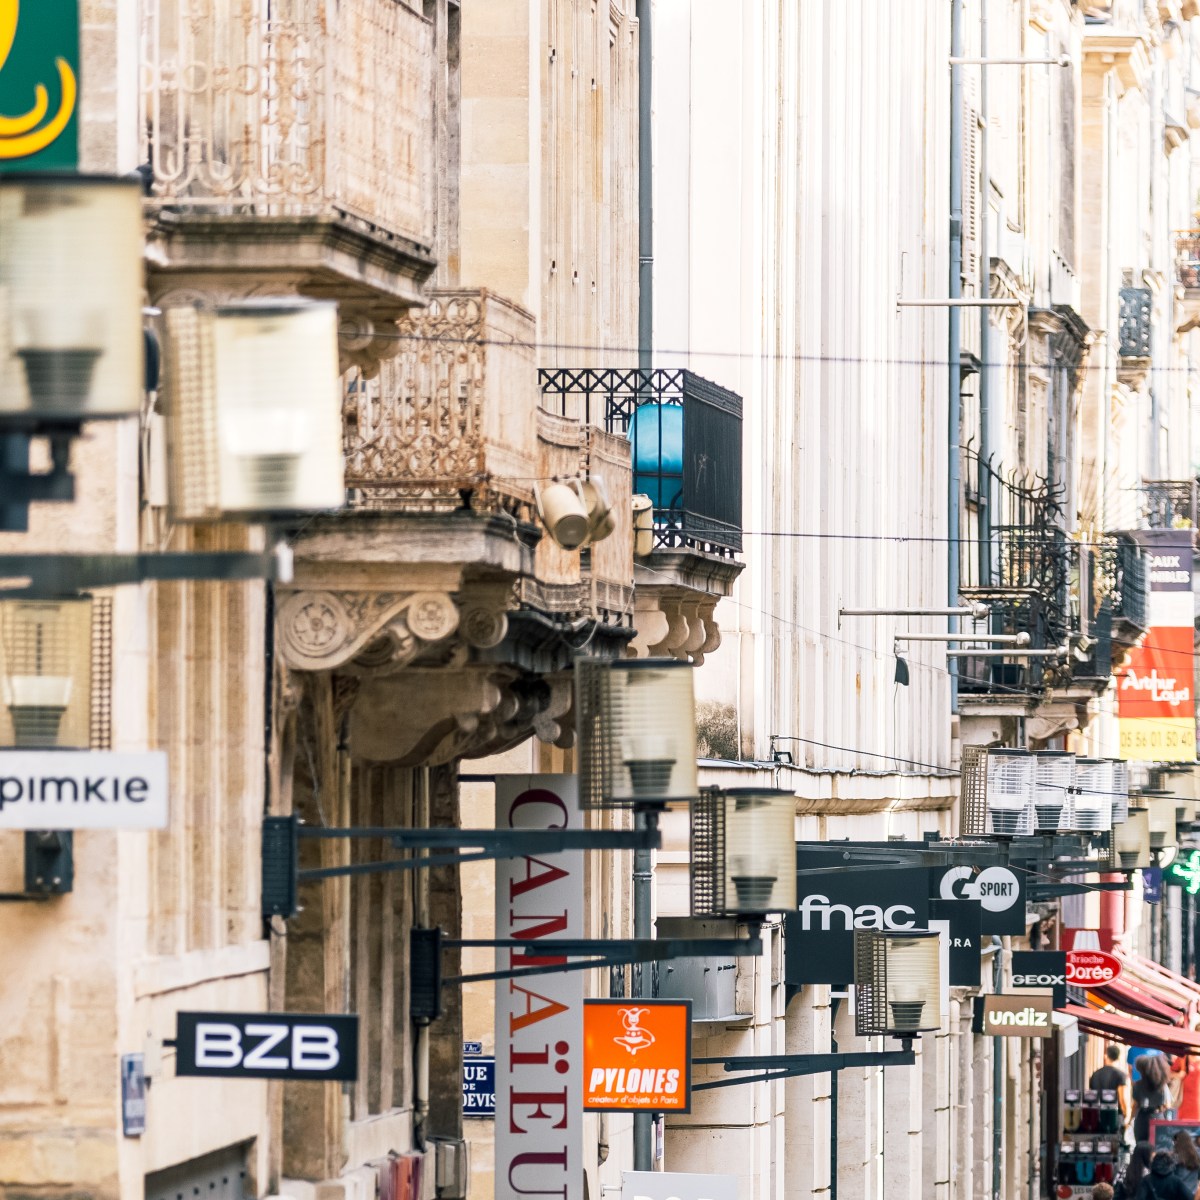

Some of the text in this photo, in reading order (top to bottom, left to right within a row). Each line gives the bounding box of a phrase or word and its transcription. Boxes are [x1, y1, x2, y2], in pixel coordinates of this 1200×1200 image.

[1122, 669, 1176, 691] Arthur
[0, 776, 149, 811] pimkie
[980, 881, 1014, 897] SPORT
[798, 894, 916, 931] fnac
[1070, 953, 1105, 964] Brioche
[1012, 974, 1066, 986] GEOX
[1066, 962, 1114, 980] Dorée
[988, 1007, 1048, 1027] undiz
[194, 1022, 342, 1071] BZB
[589, 1067, 680, 1094] PYLONES
[588, 1095, 679, 1106] créateur d'objets à Paris
